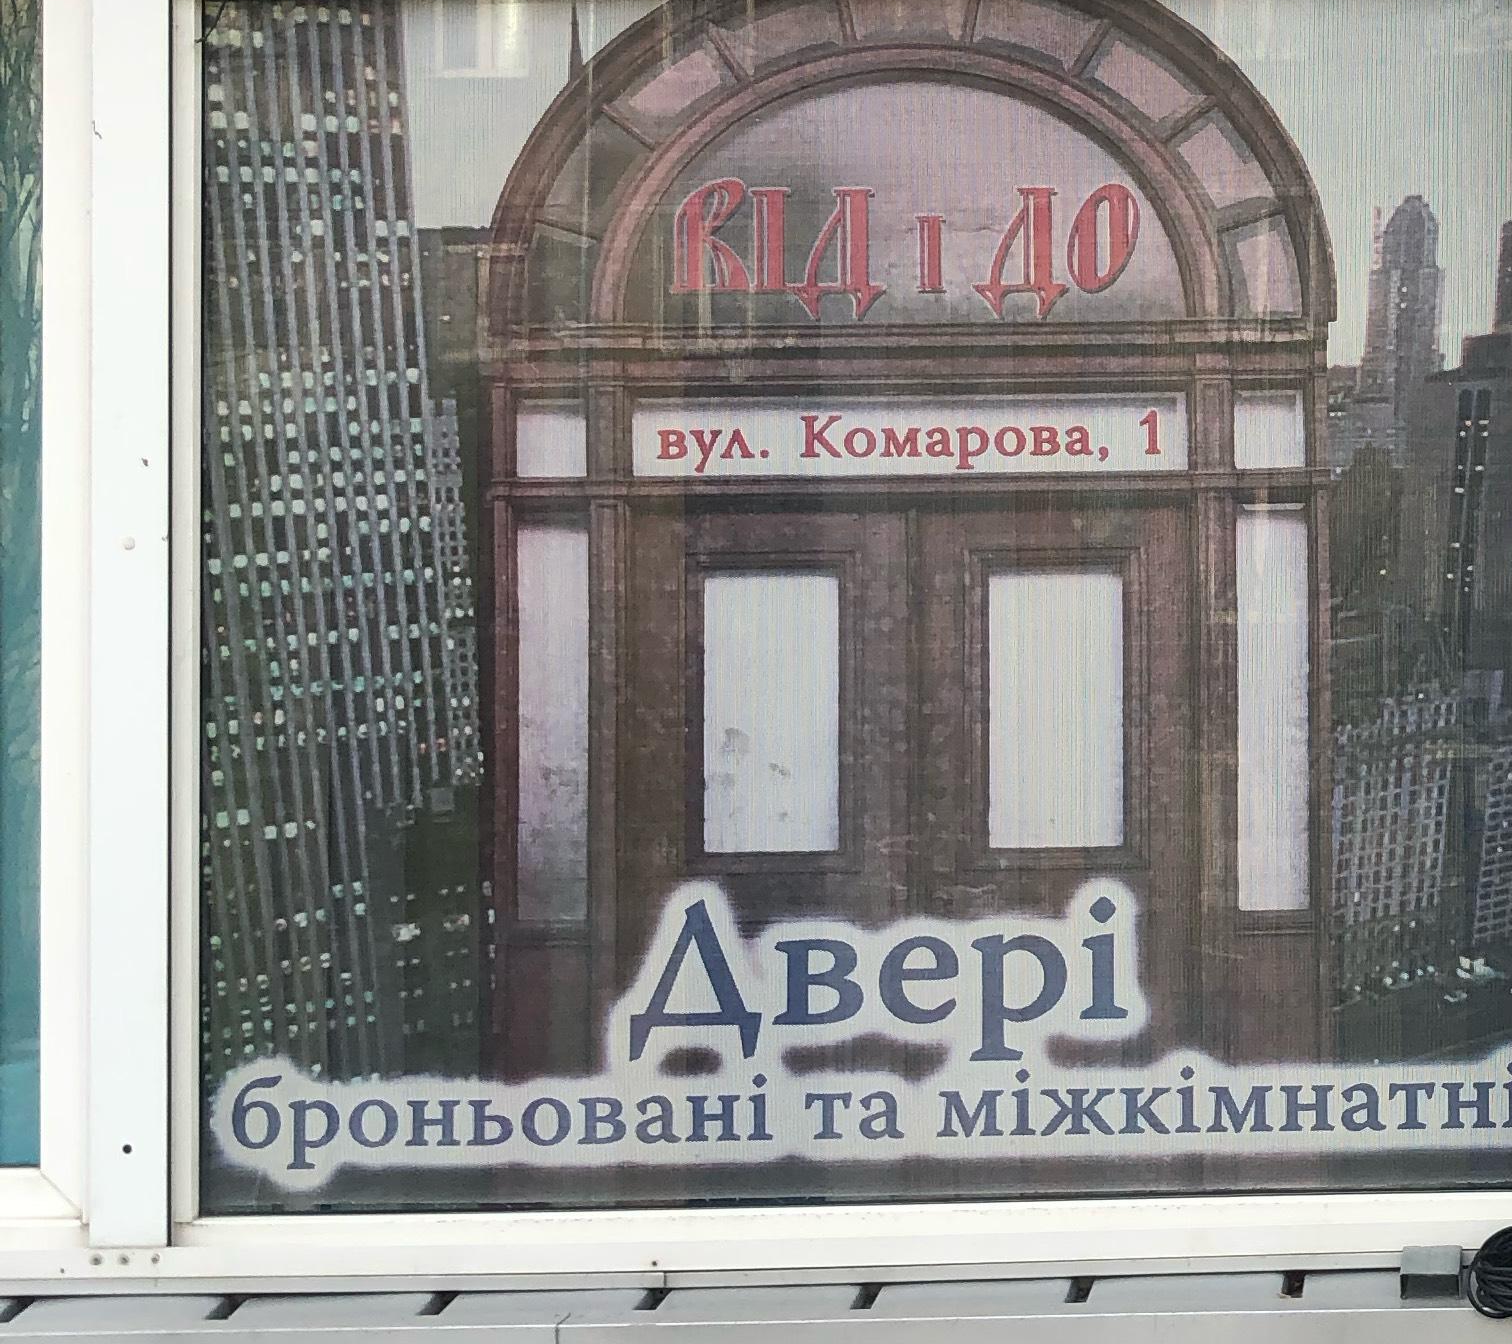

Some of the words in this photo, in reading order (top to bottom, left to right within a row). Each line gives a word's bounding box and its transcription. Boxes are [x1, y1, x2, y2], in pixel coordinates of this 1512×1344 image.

[671, 177, 887, 319] ВІД
[972, 183, 1141, 319] ДО
[656, 425, 770, 473] вул.
[799, 413, 1110, 470] Комарова,
[1140, 410, 1162, 456] 1
[629, 897, 1130, 1062] Двері
[231, 1073, 773, 1169] броньовані
[804, 1089, 905, 1140] та
